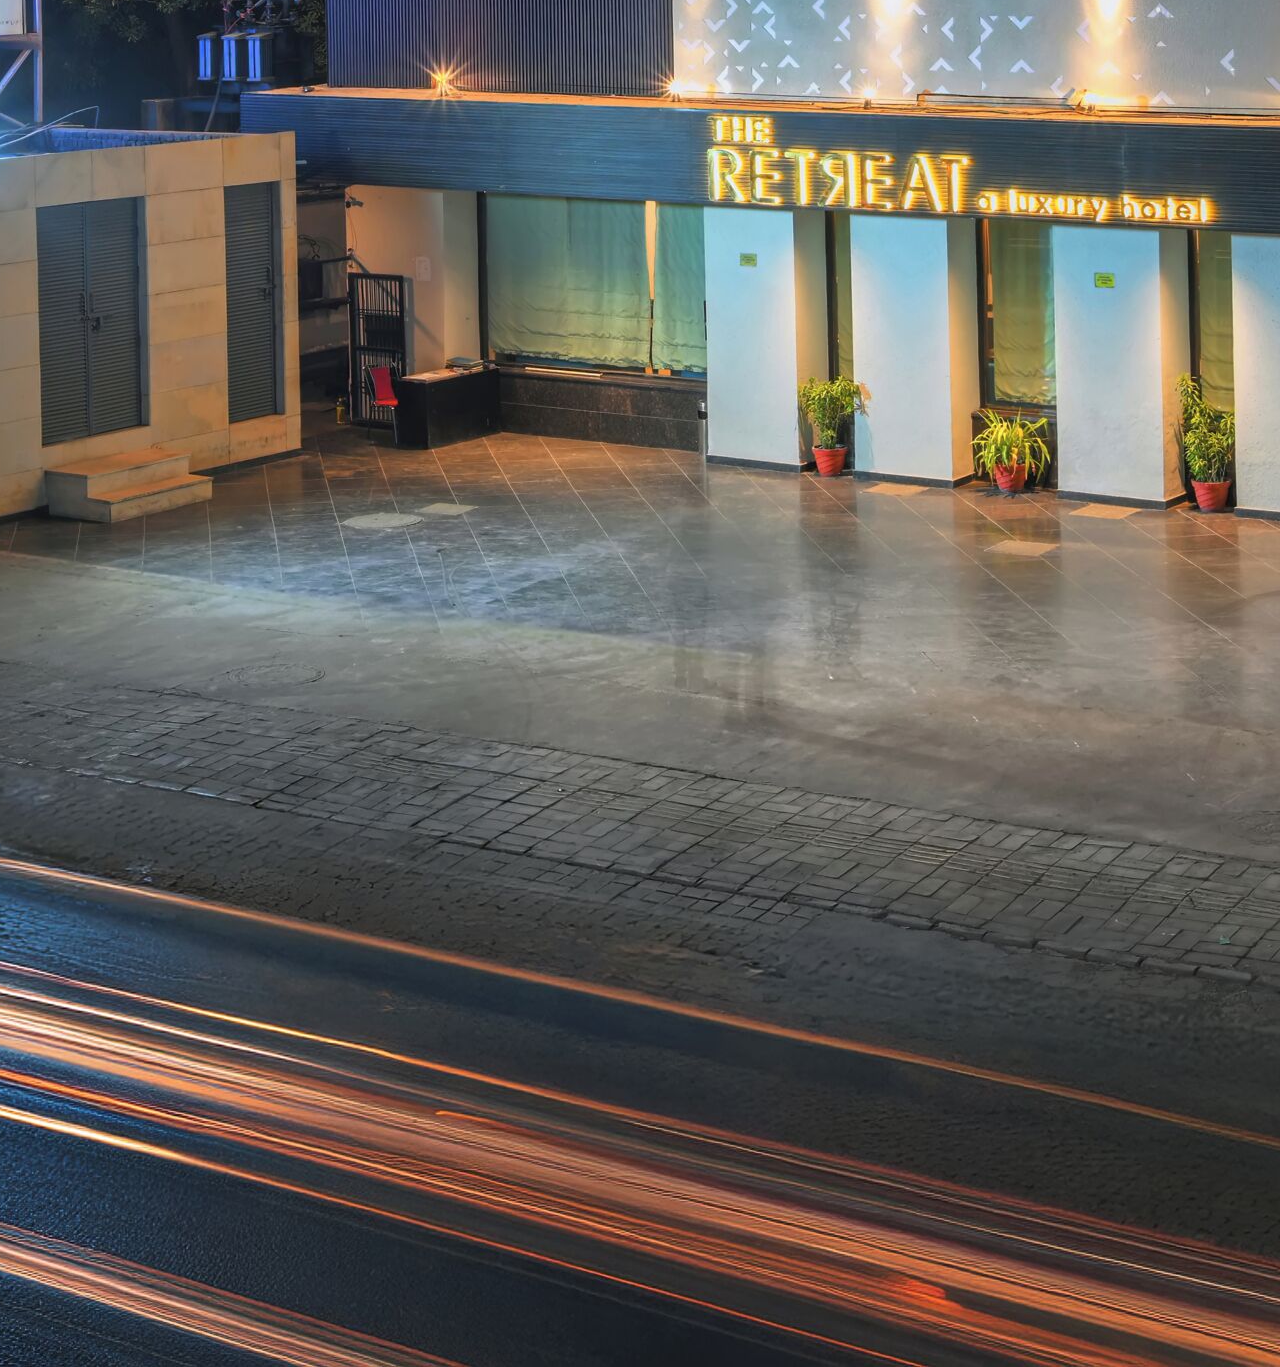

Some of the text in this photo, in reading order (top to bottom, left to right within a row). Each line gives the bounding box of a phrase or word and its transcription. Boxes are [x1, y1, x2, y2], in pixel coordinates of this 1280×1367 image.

[706, 116, 773, 143] THE
[707, 147, 973, 213] RETREAT
[977, 188, 1208, 224] a luxury hotel
